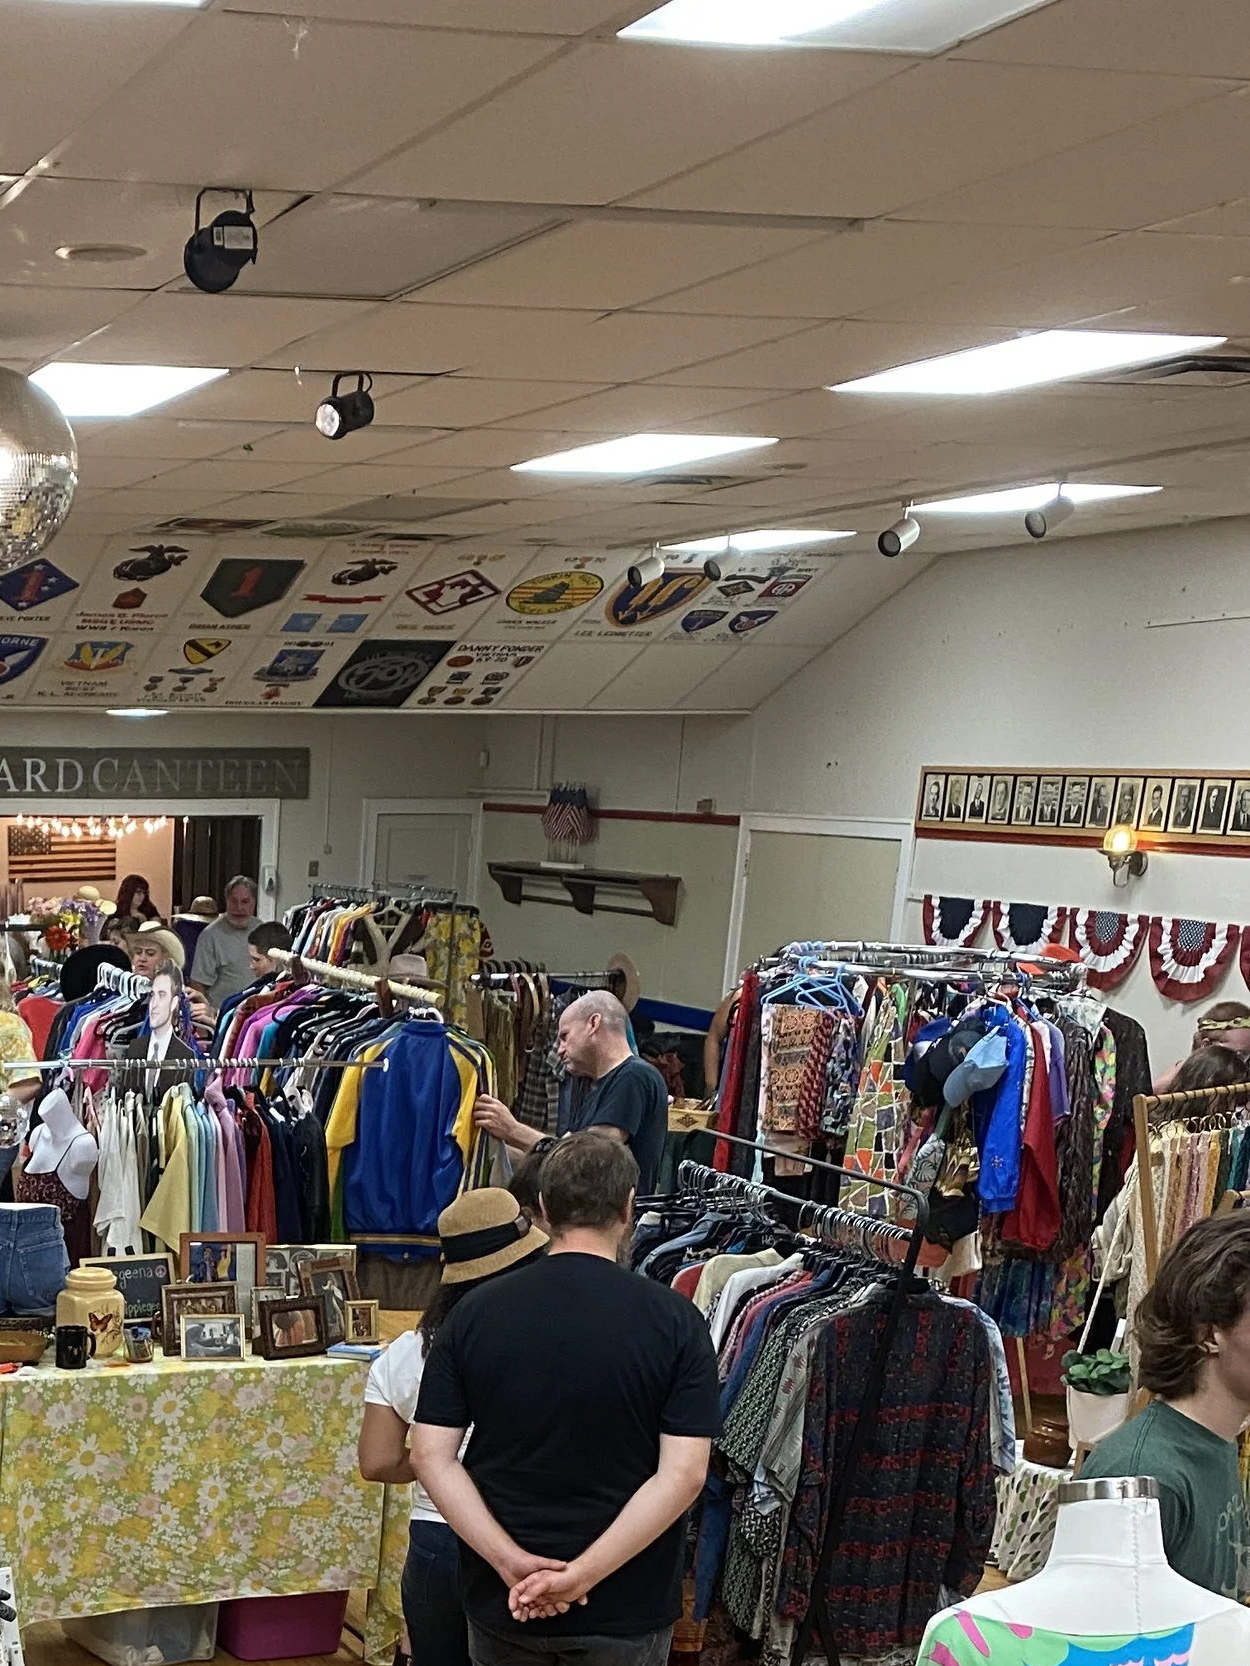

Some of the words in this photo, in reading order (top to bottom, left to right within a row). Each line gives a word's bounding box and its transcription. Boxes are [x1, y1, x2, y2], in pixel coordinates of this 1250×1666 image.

[233, 564, 265, 597] 1
[457, 644, 500, 653] DANNY
[499, 645, 545, 653] PONDER
[92, 756, 302, 794] CANTEEN
[115, 1266, 154, 1290] geena
[125, 1298, 161, 1318] ippiegee
